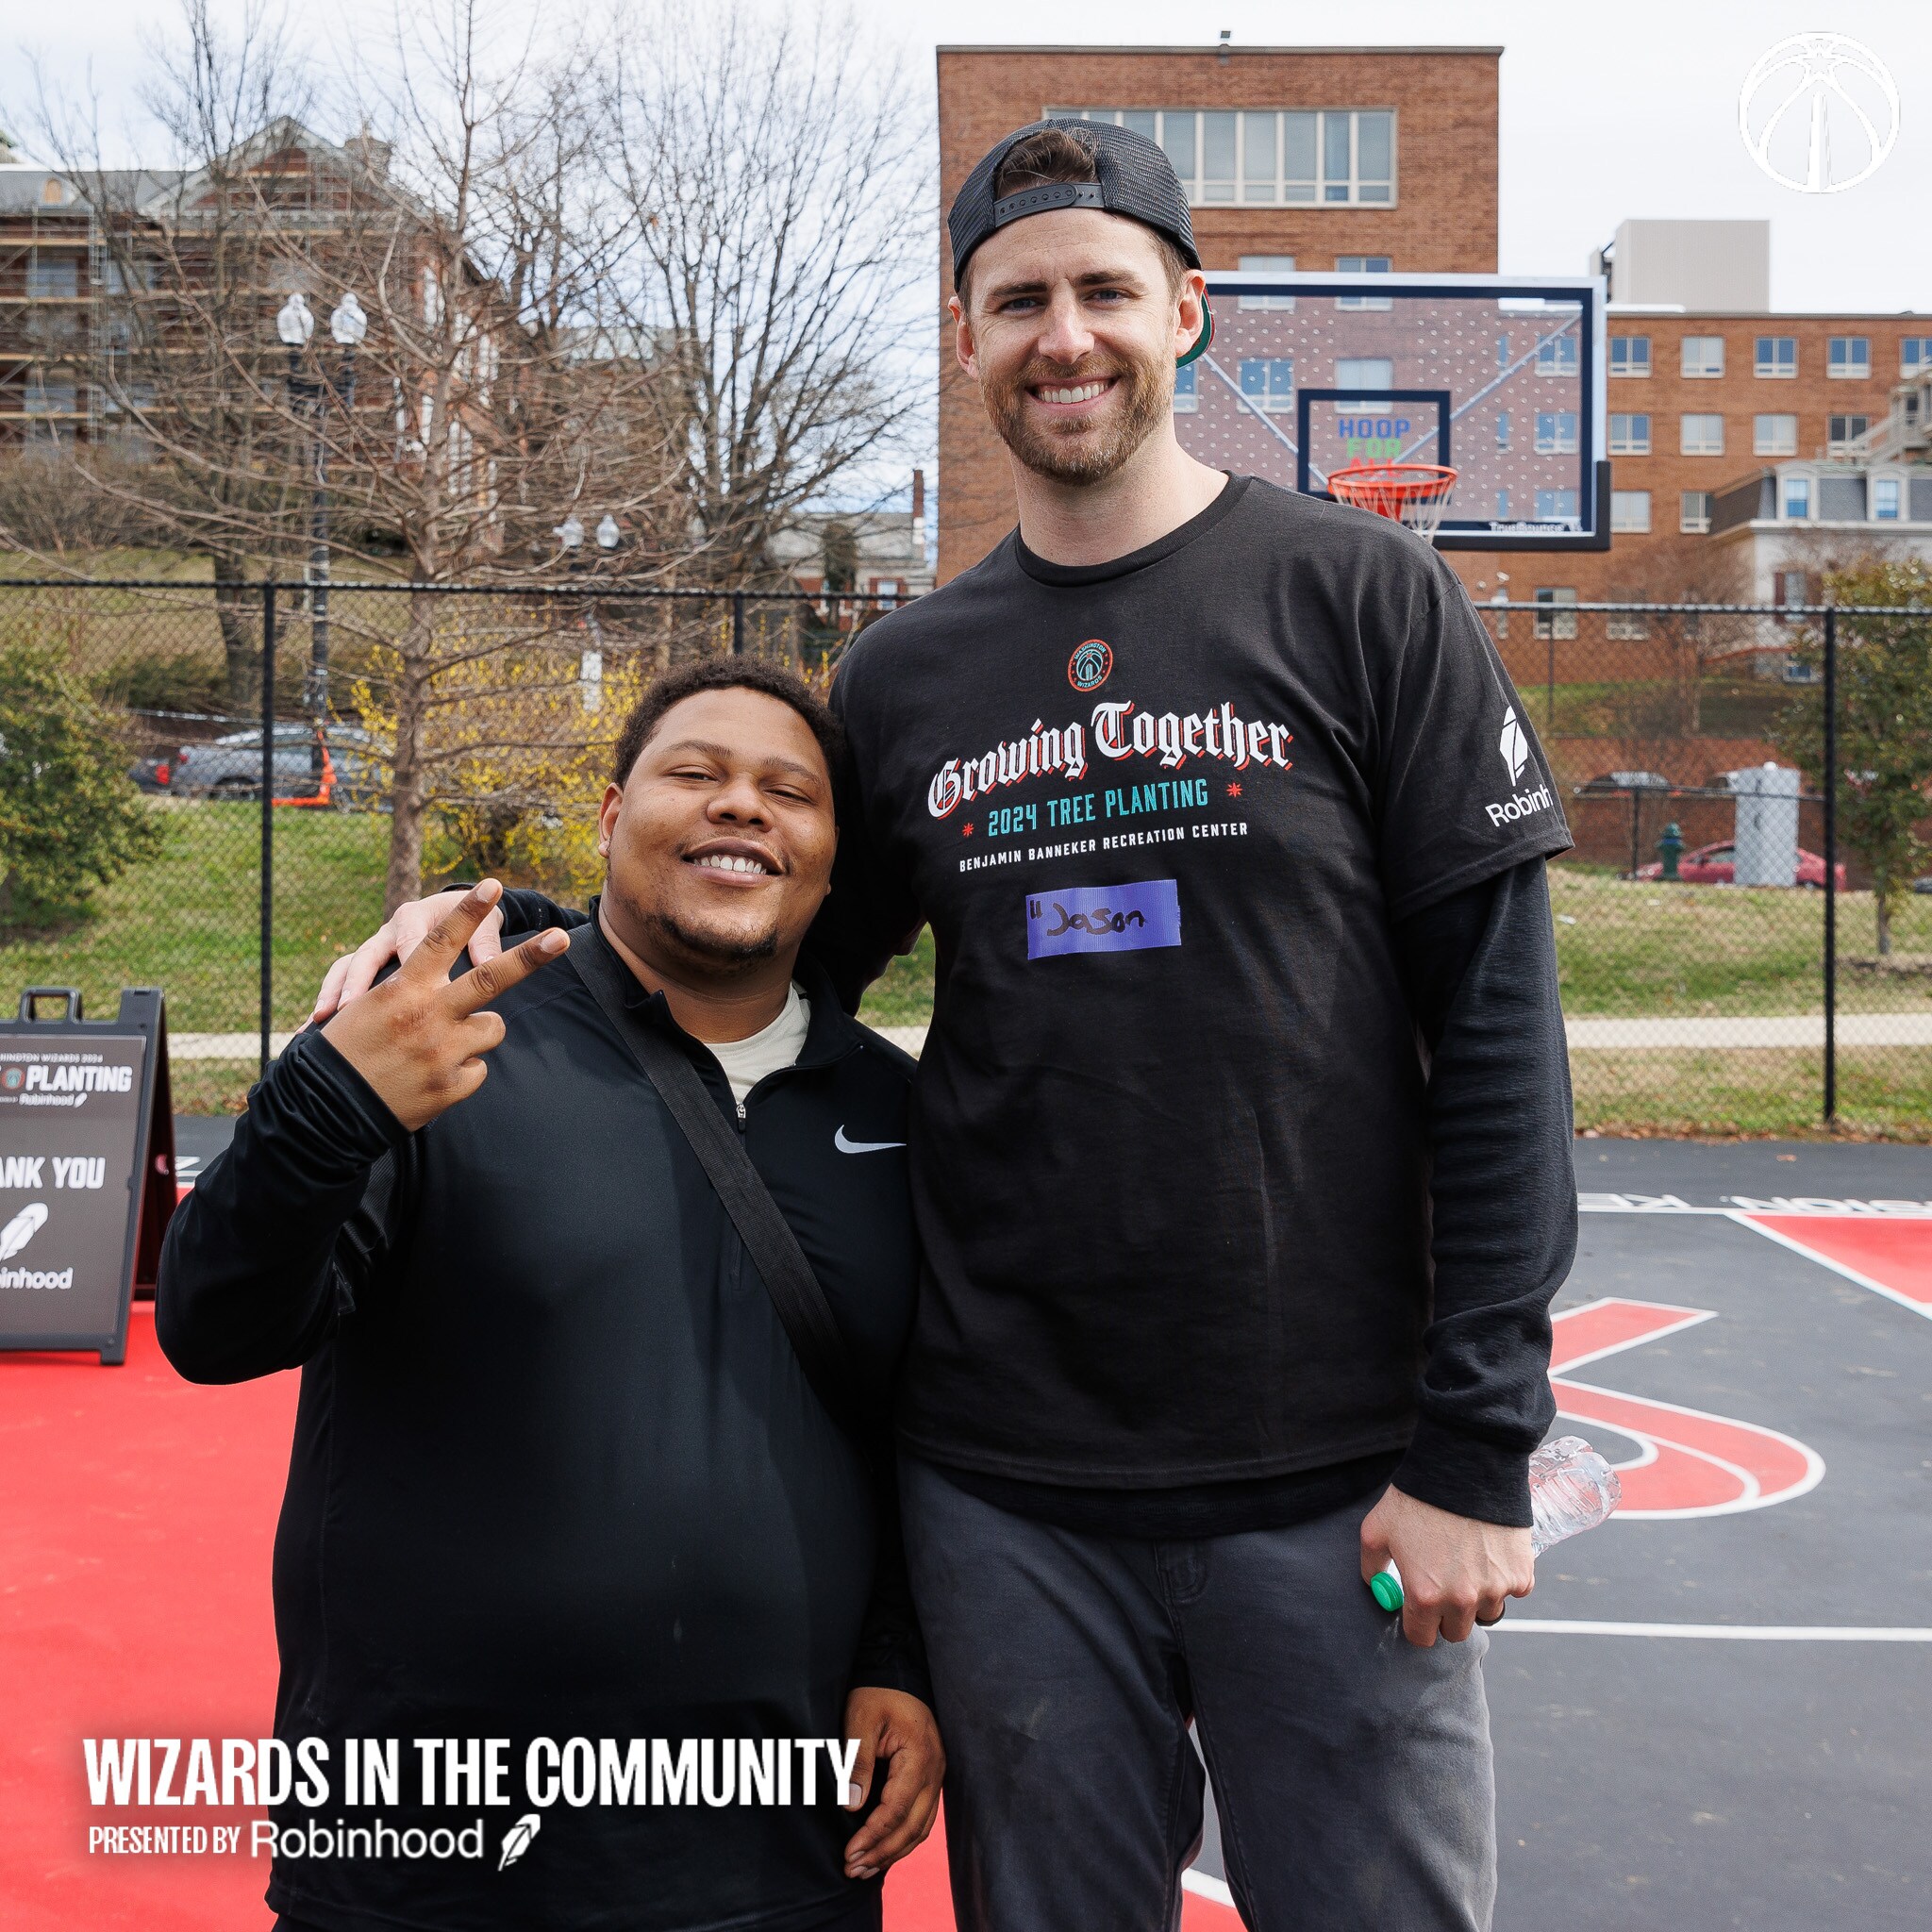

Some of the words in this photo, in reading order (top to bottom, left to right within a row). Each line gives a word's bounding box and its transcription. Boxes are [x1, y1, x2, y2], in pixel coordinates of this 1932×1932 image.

[1338, 418, 1411, 439] HOOP
[1346, 439, 1402, 459] FOR
[1074, 642, 1107, 659] WASHINGTON
[1076, 675, 1103, 688] WIZARDS
[927, 718, 1088, 819] Growing
[1091, 700, 1293, 770] Together
[988, 804, 1037, 837] 2024
[1047, 793, 1096, 826] TREE
[1105, 778, 1208, 818] PLANTING
[959, 850, 1022, 872] BENJAMIN
[1028, 839, 1096, 860] BANNEKER
[1103, 826, 1185, 849] RECREATION
[1192, 822, 1248, 838] CENTER
[25, 1064, 133, 1091] PLANTING
[52, 1157, 106, 1189] YOU
